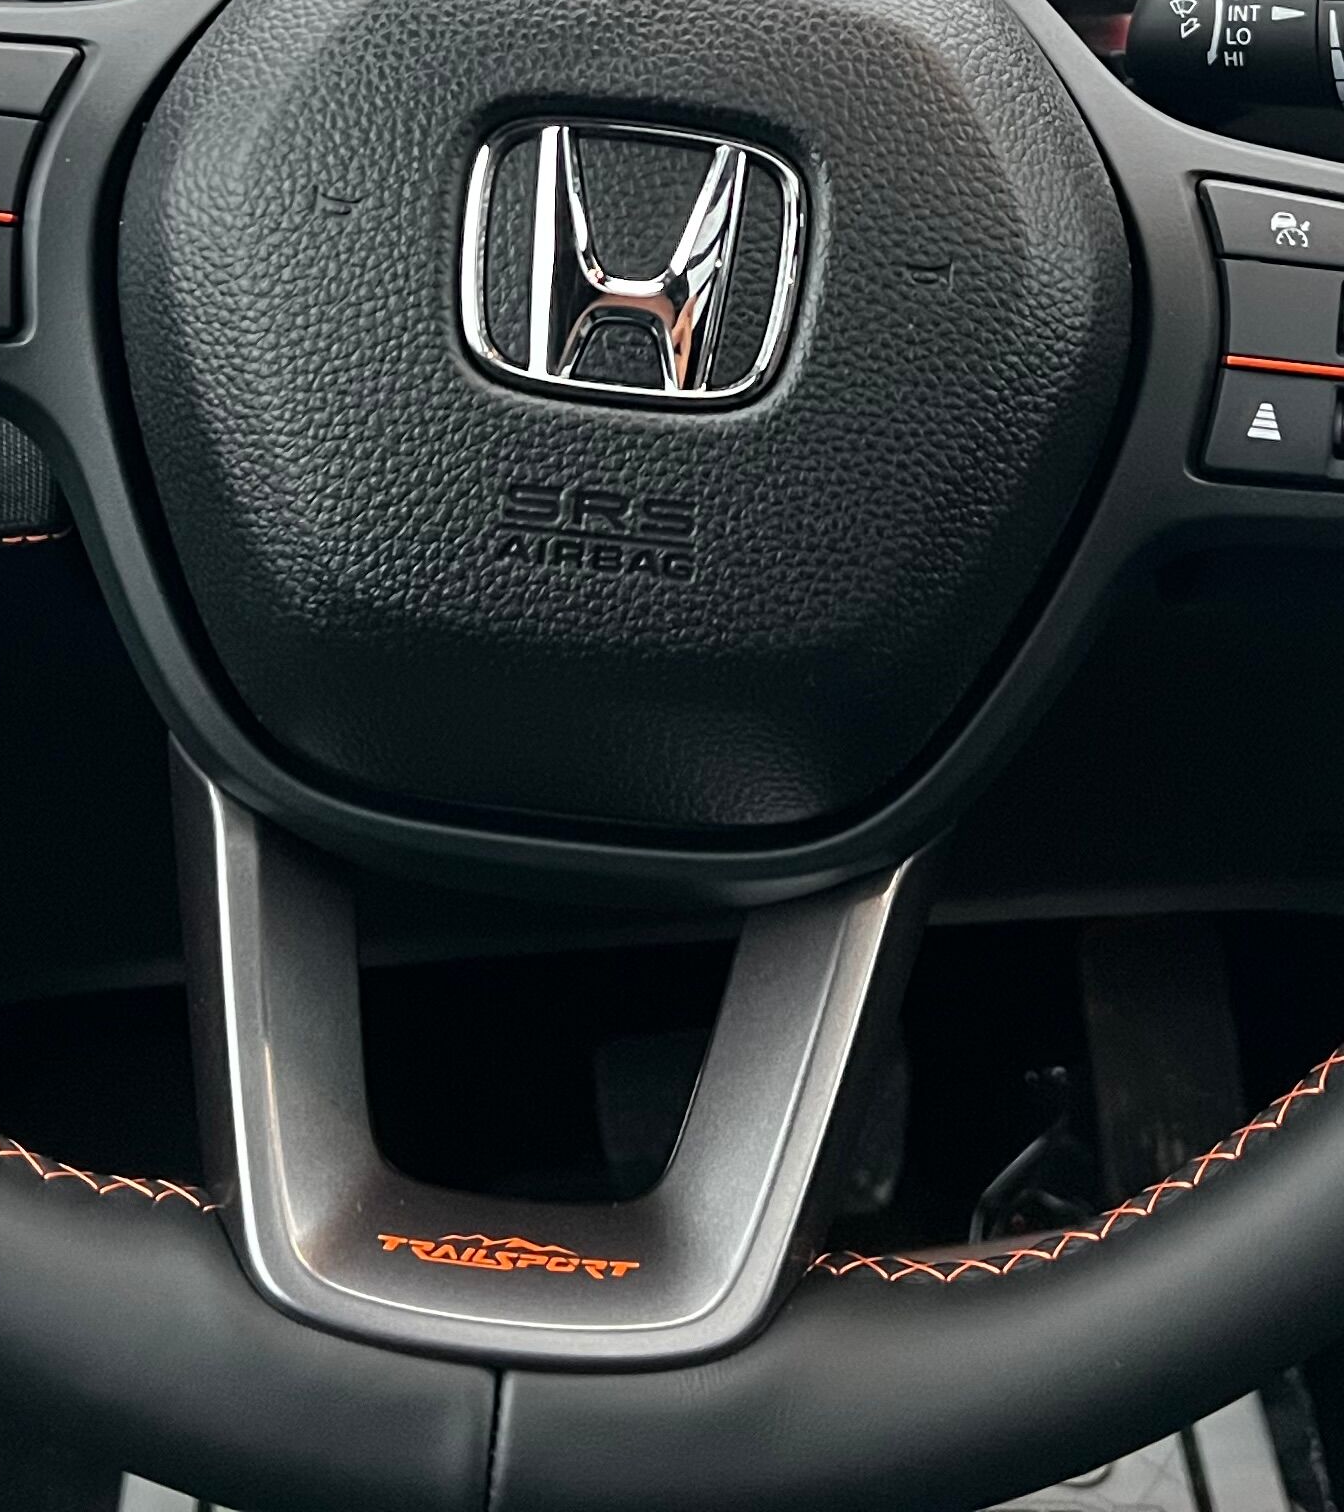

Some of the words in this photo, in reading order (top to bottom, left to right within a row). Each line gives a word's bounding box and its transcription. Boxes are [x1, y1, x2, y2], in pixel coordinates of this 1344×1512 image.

[1228, 5, 1261, 22] INT
[1226, 28, 1252, 45] LO
[1224, 51, 1244, 67] HI
[504, 484, 695, 533] SRS
[497, 533, 694, 581] AIRBAG
[377, 1233, 640, 1280] TRAILSPORT
